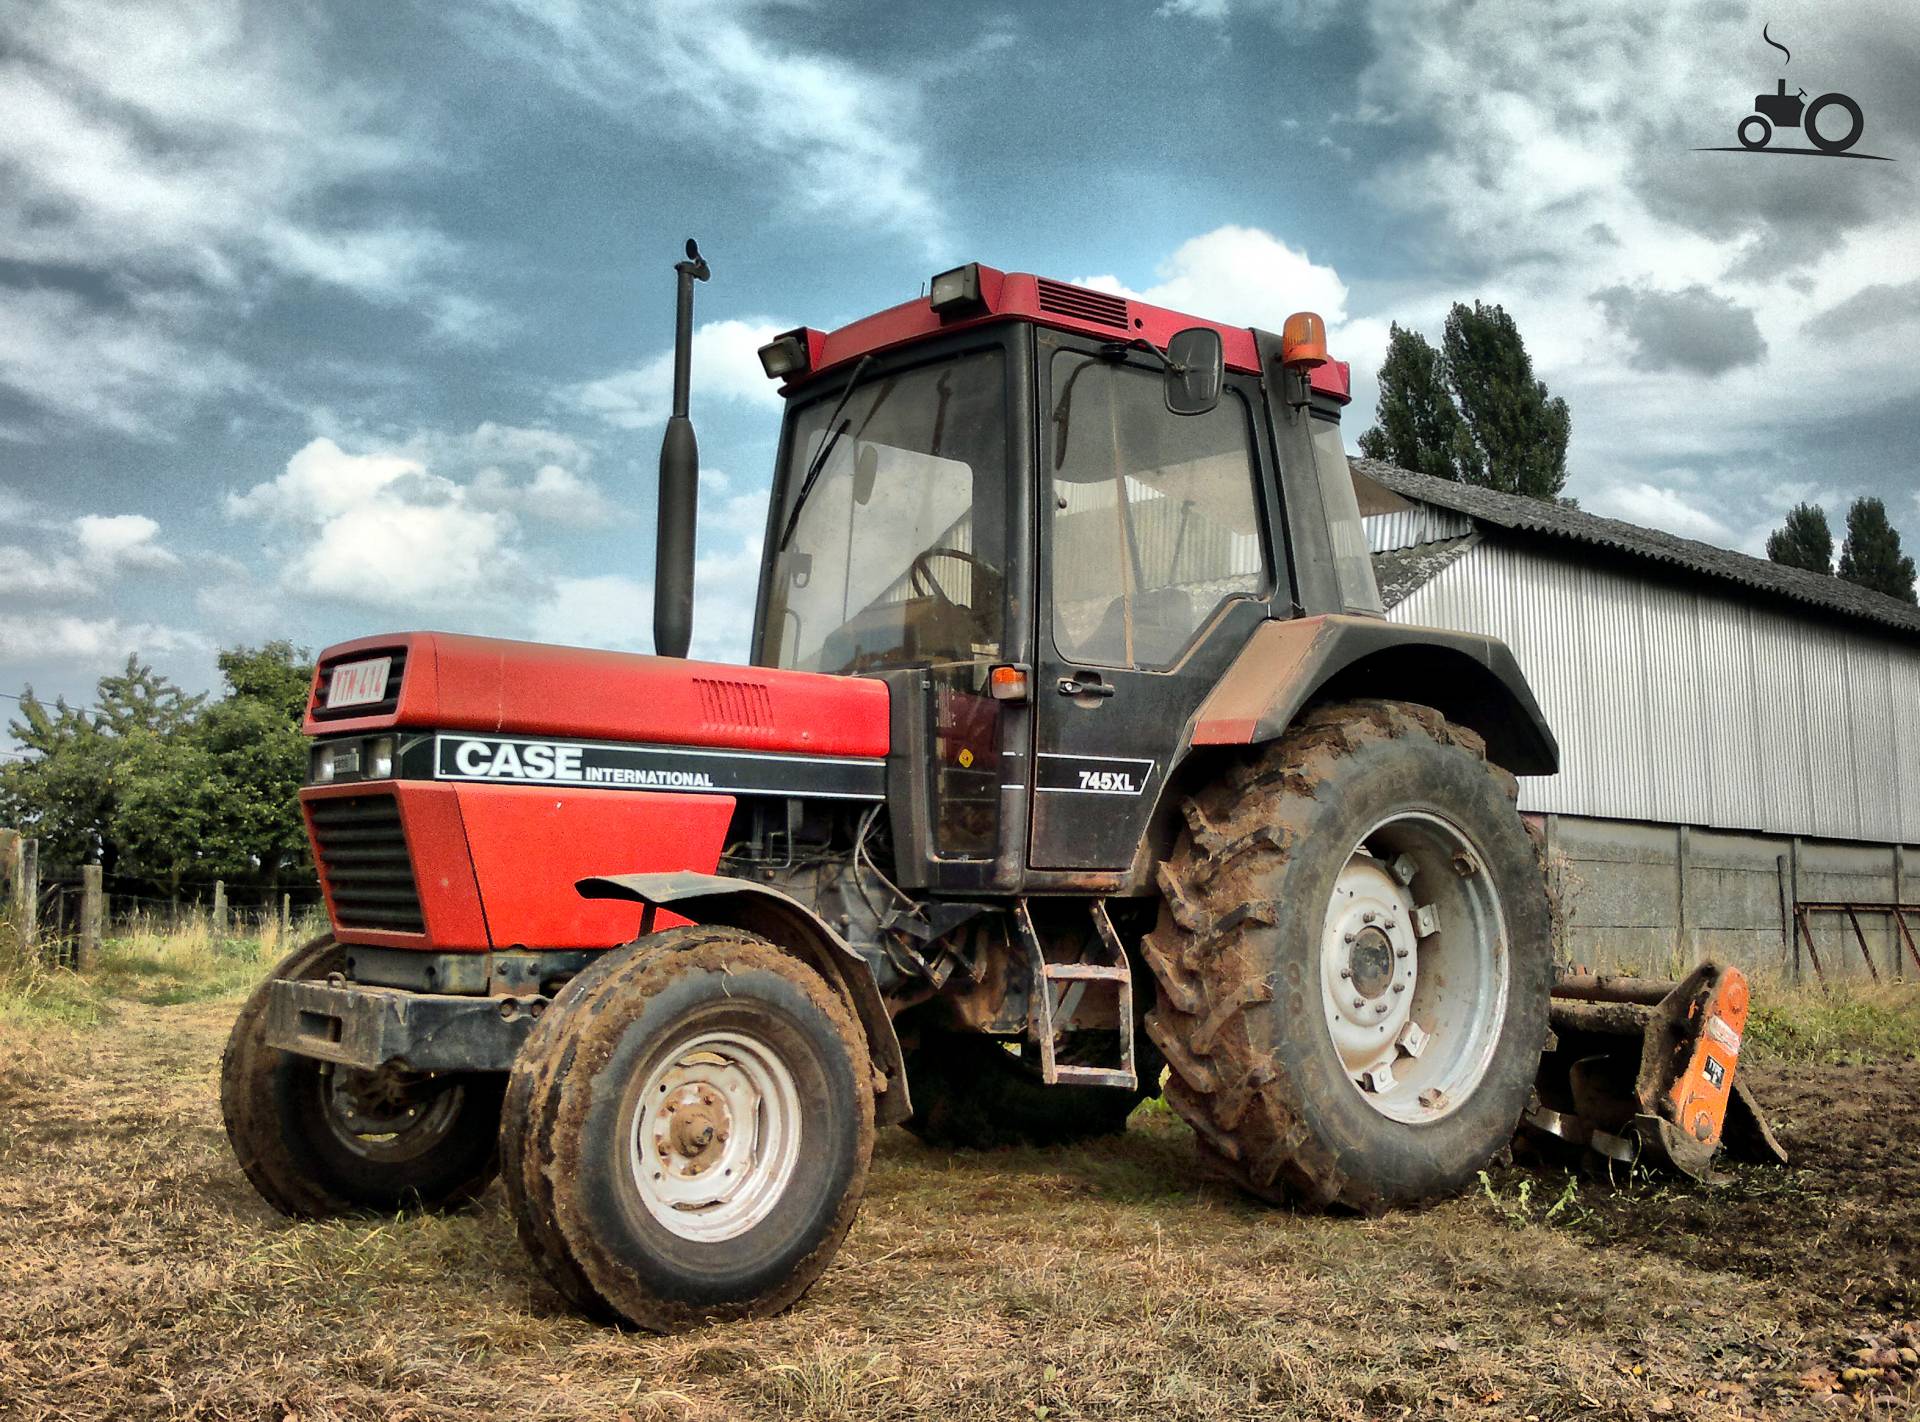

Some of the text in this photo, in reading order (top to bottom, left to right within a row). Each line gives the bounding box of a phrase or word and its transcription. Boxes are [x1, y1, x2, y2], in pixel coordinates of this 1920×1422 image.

[455, 741, 713, 787] CASE INTERNATIONAL
[1079, 771, 1135, 791] 745XL
